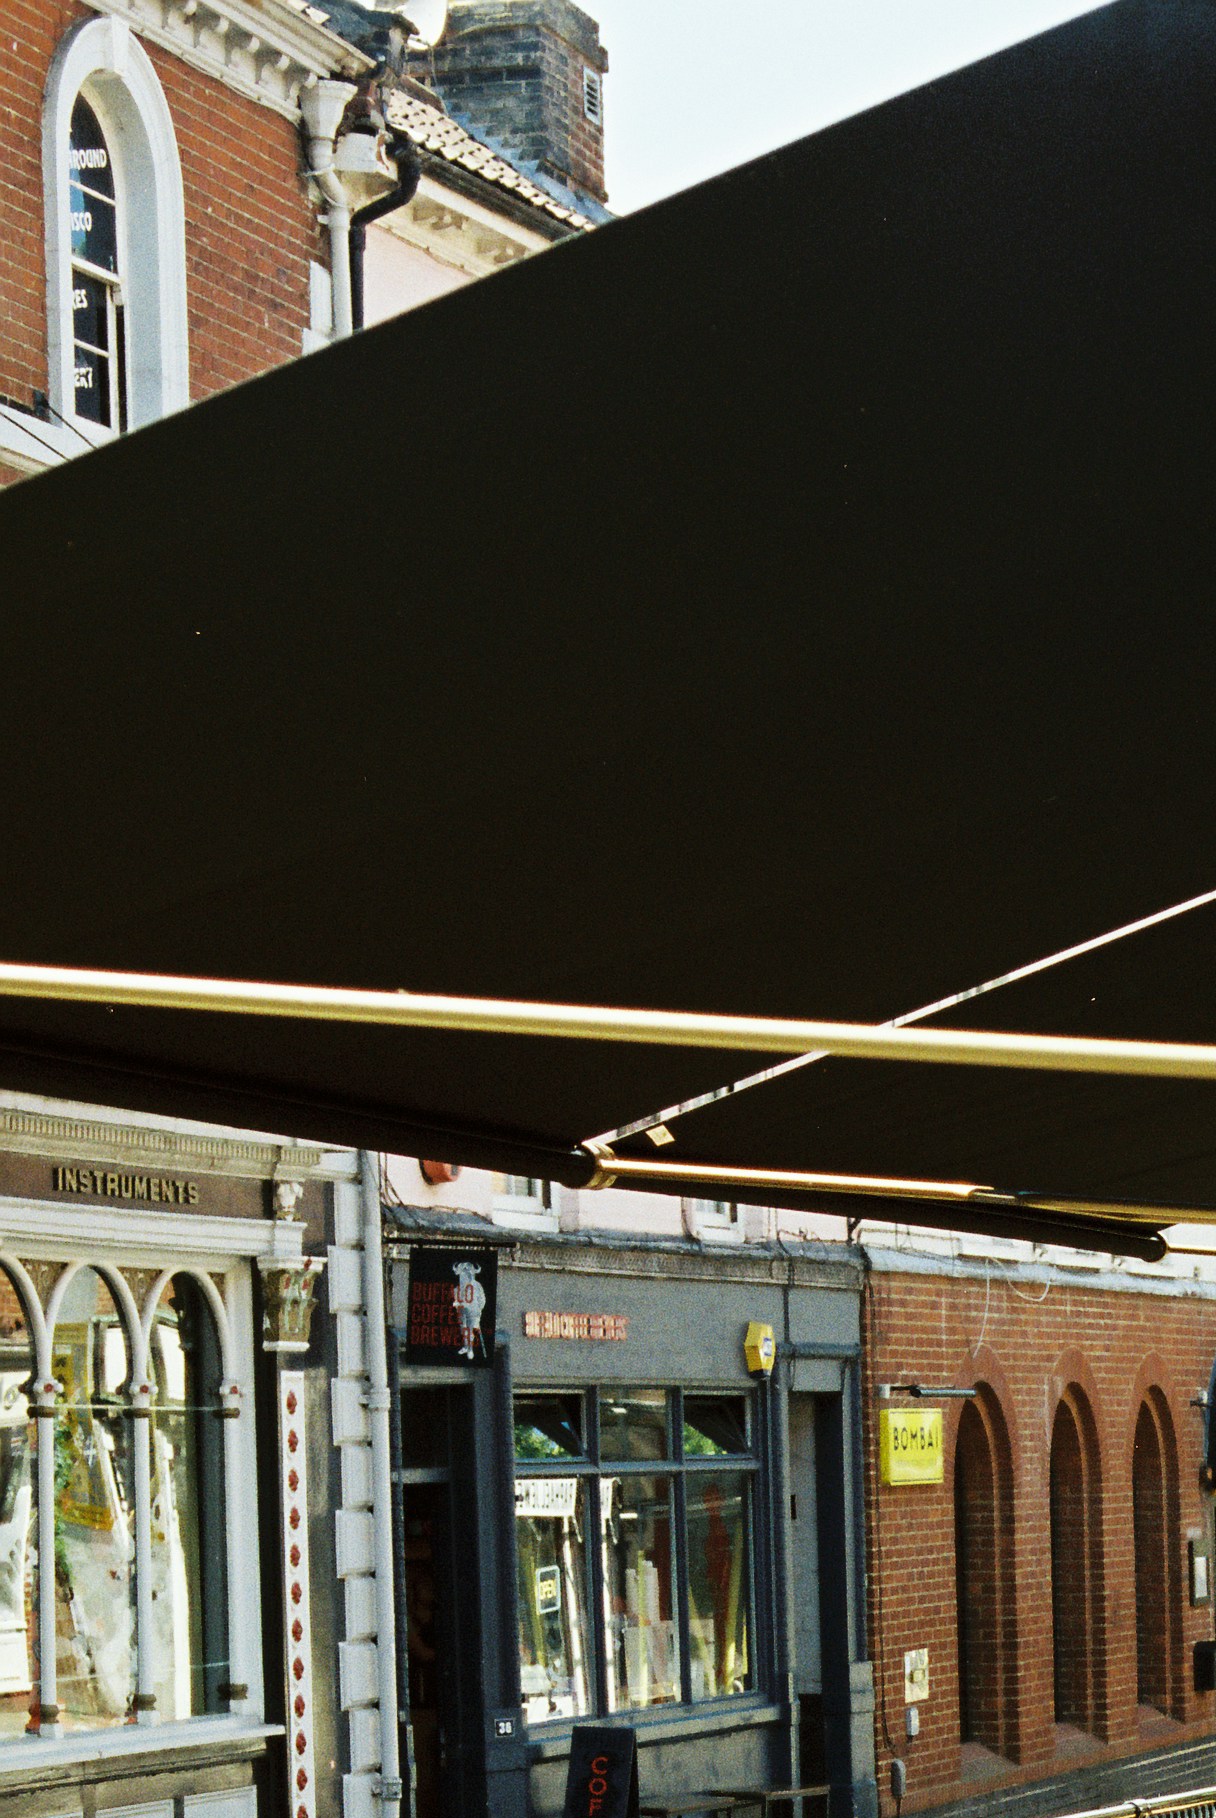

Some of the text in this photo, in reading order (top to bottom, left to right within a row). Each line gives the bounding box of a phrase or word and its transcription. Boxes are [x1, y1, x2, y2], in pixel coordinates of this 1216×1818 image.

[53, 1166, 200, 1204] INSTRUMENTS
[411, 1281, 475, 1304] BUFFALO
[411, 1303, 465, 1325] COFFEE
[410, 1325, 481, 1347] BREWERS
[893, 1426, 940, 1451] BOMBAI
